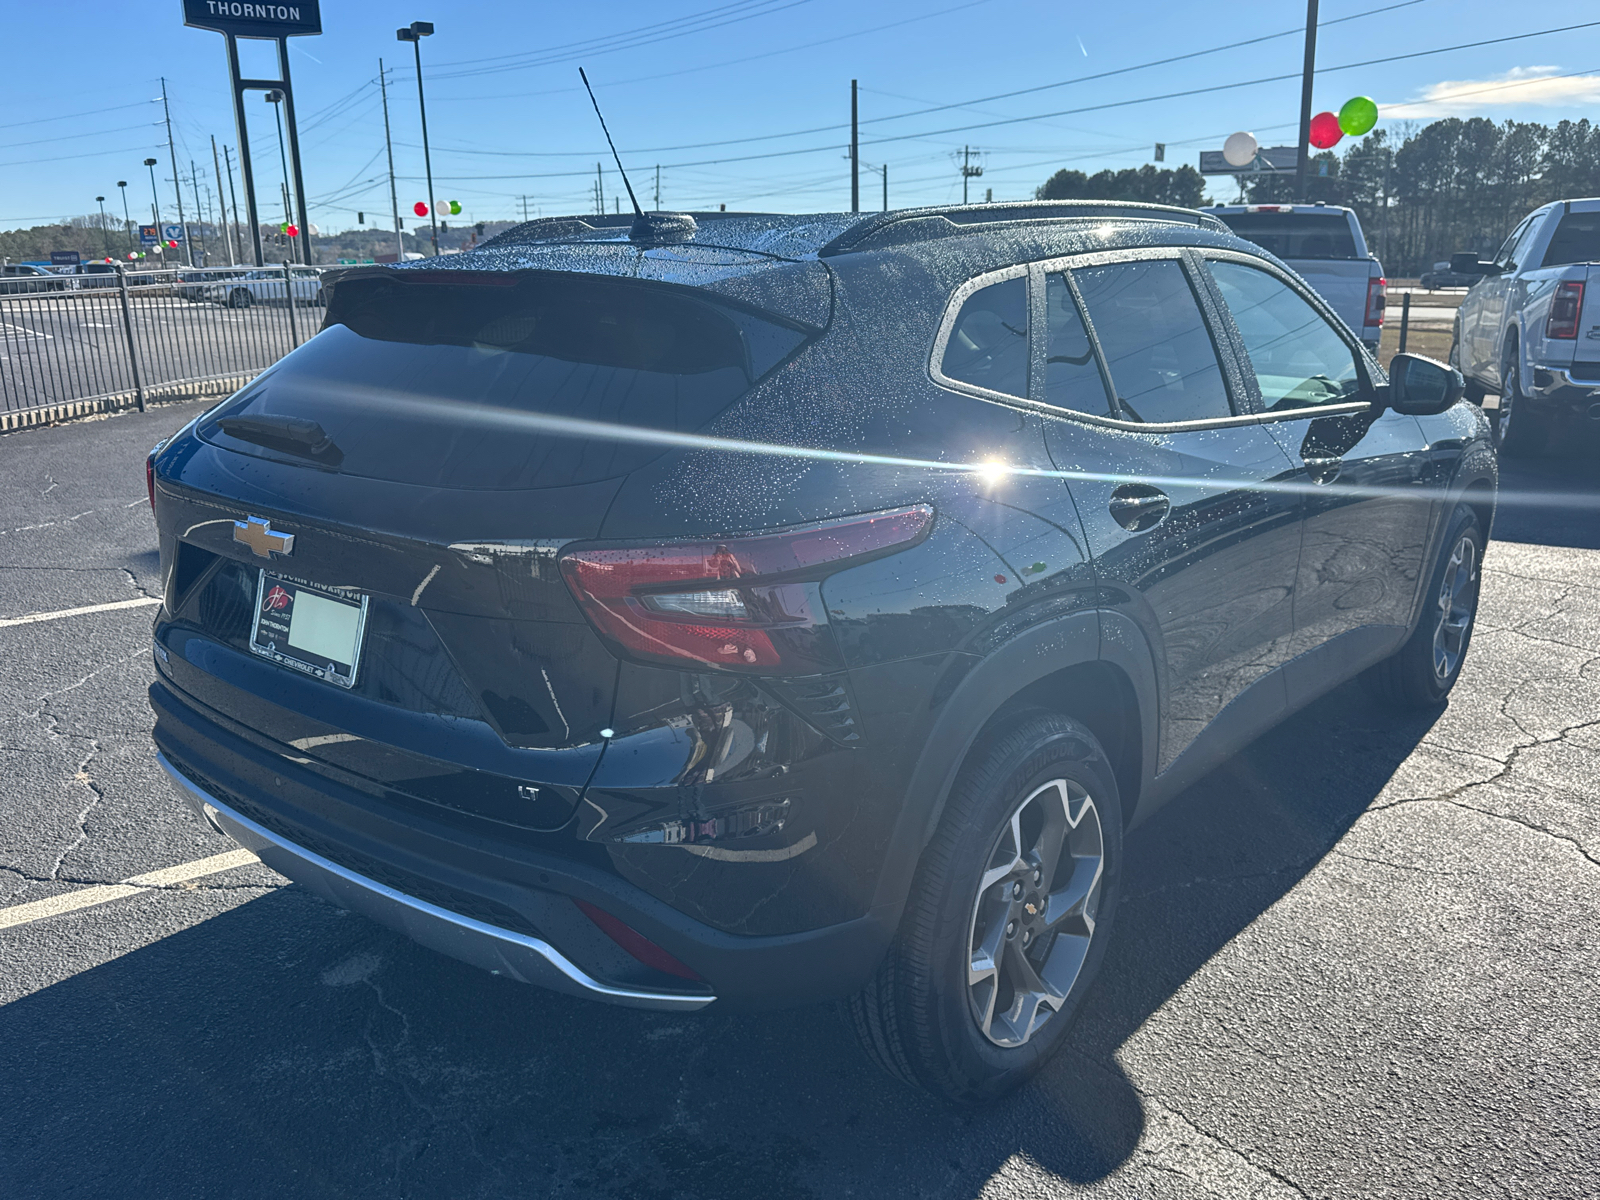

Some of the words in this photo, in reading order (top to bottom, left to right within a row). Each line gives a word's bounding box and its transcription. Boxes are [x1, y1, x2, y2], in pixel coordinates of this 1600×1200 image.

[206, 0, 300, 20] THORNTON
[283, 657, 315, 674] CHEVROLET
[517, 785, 540, 801] LT
